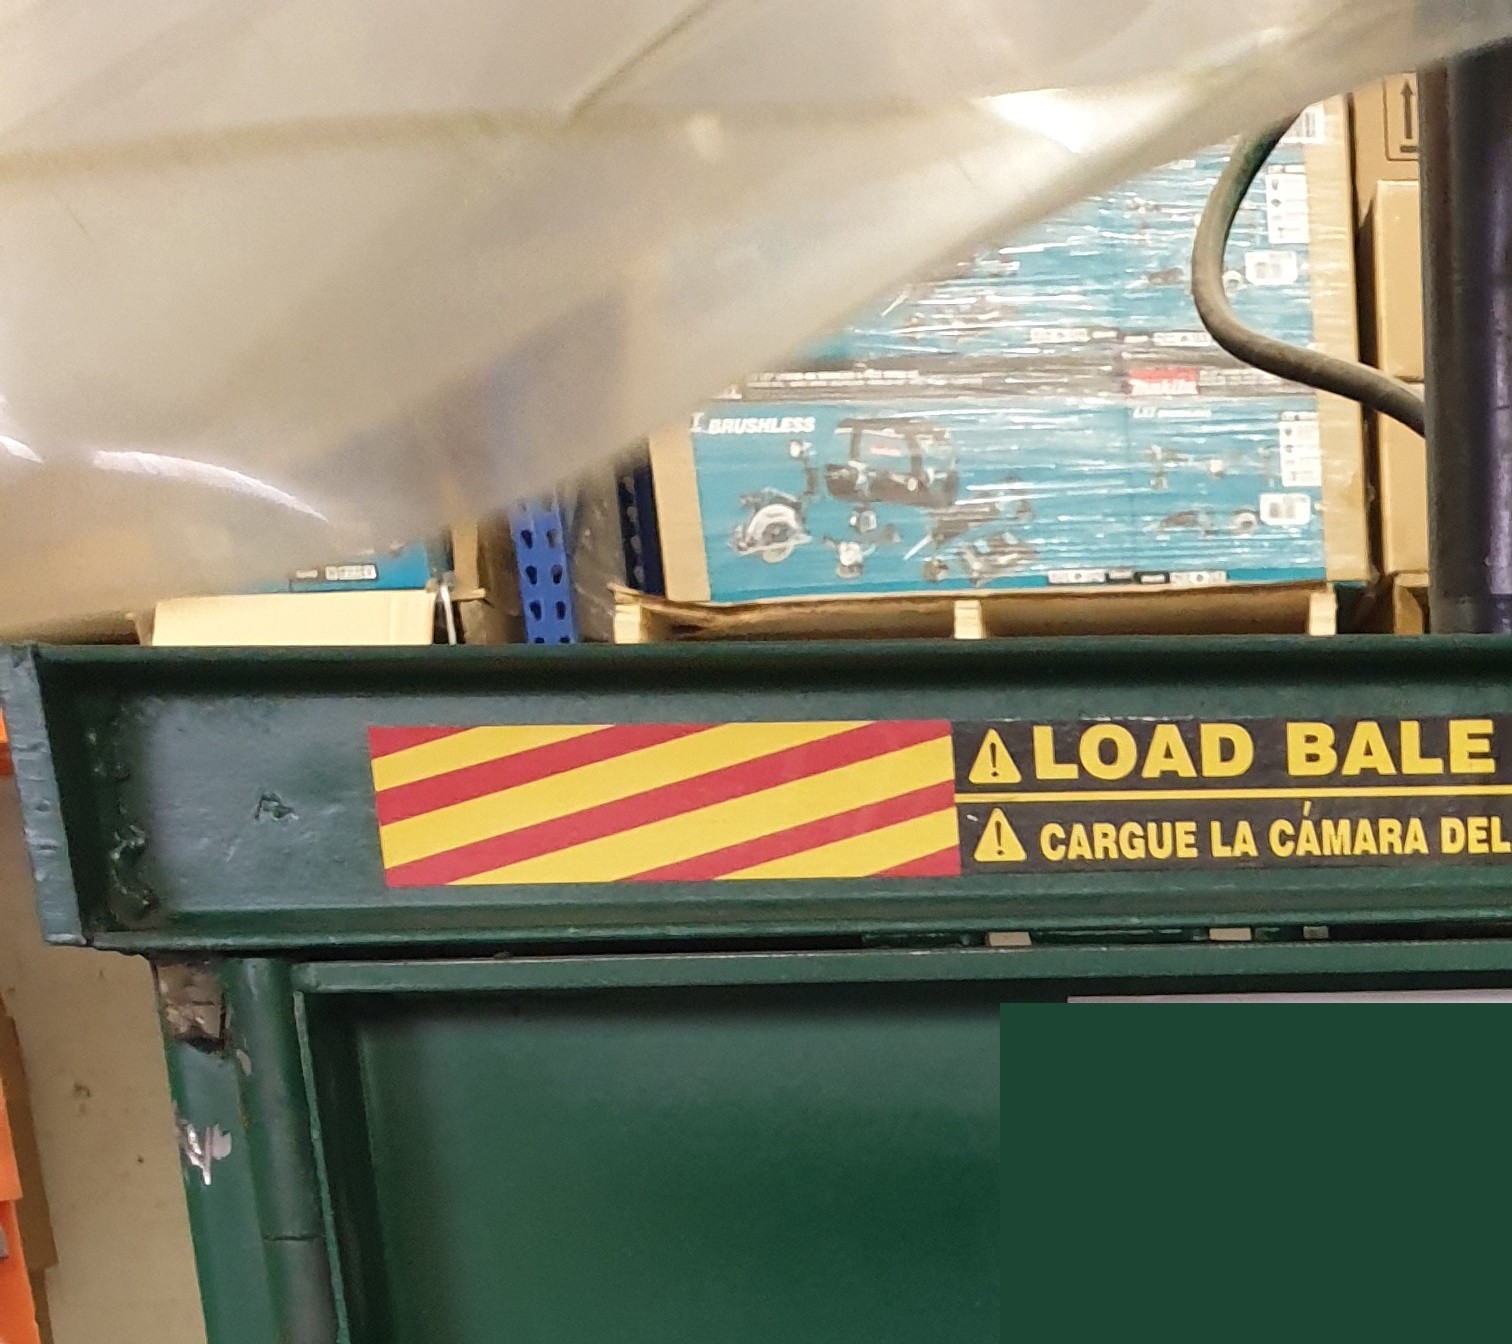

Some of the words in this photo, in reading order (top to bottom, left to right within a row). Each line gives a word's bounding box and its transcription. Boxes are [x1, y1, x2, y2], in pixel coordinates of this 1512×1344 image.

[708, 417, 815, 434] BRUSHLESS
[1033, 723, 1255, 780] LOAD
[1286, 718, 1494, 777] BALE
[1040, 820, 1197, 861] CARGUE
[1210, 819, 1256, 857] LA
[1270, 801, 1428, 857] CÁMARA
[1441, 816, 1510, 854] DEL
